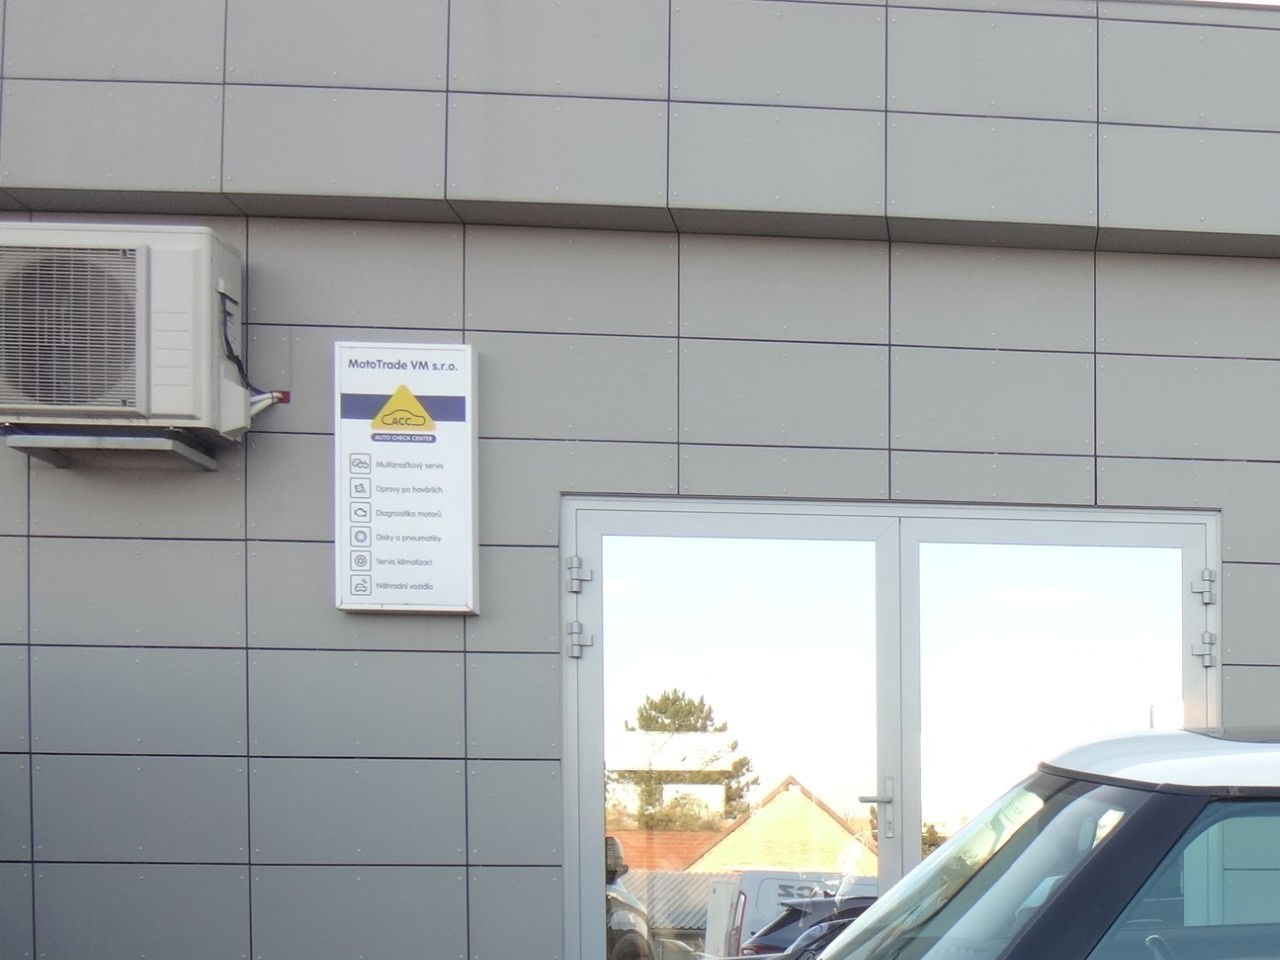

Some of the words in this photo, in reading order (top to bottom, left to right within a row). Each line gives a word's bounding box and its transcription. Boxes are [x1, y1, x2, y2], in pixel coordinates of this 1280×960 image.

[348, 359, 408, 370] MotoTrade
[411, 361, 429, 371] VM
[432, 362, 459, 371] s.r.o.
[391, 418, 412, 426] ACC
